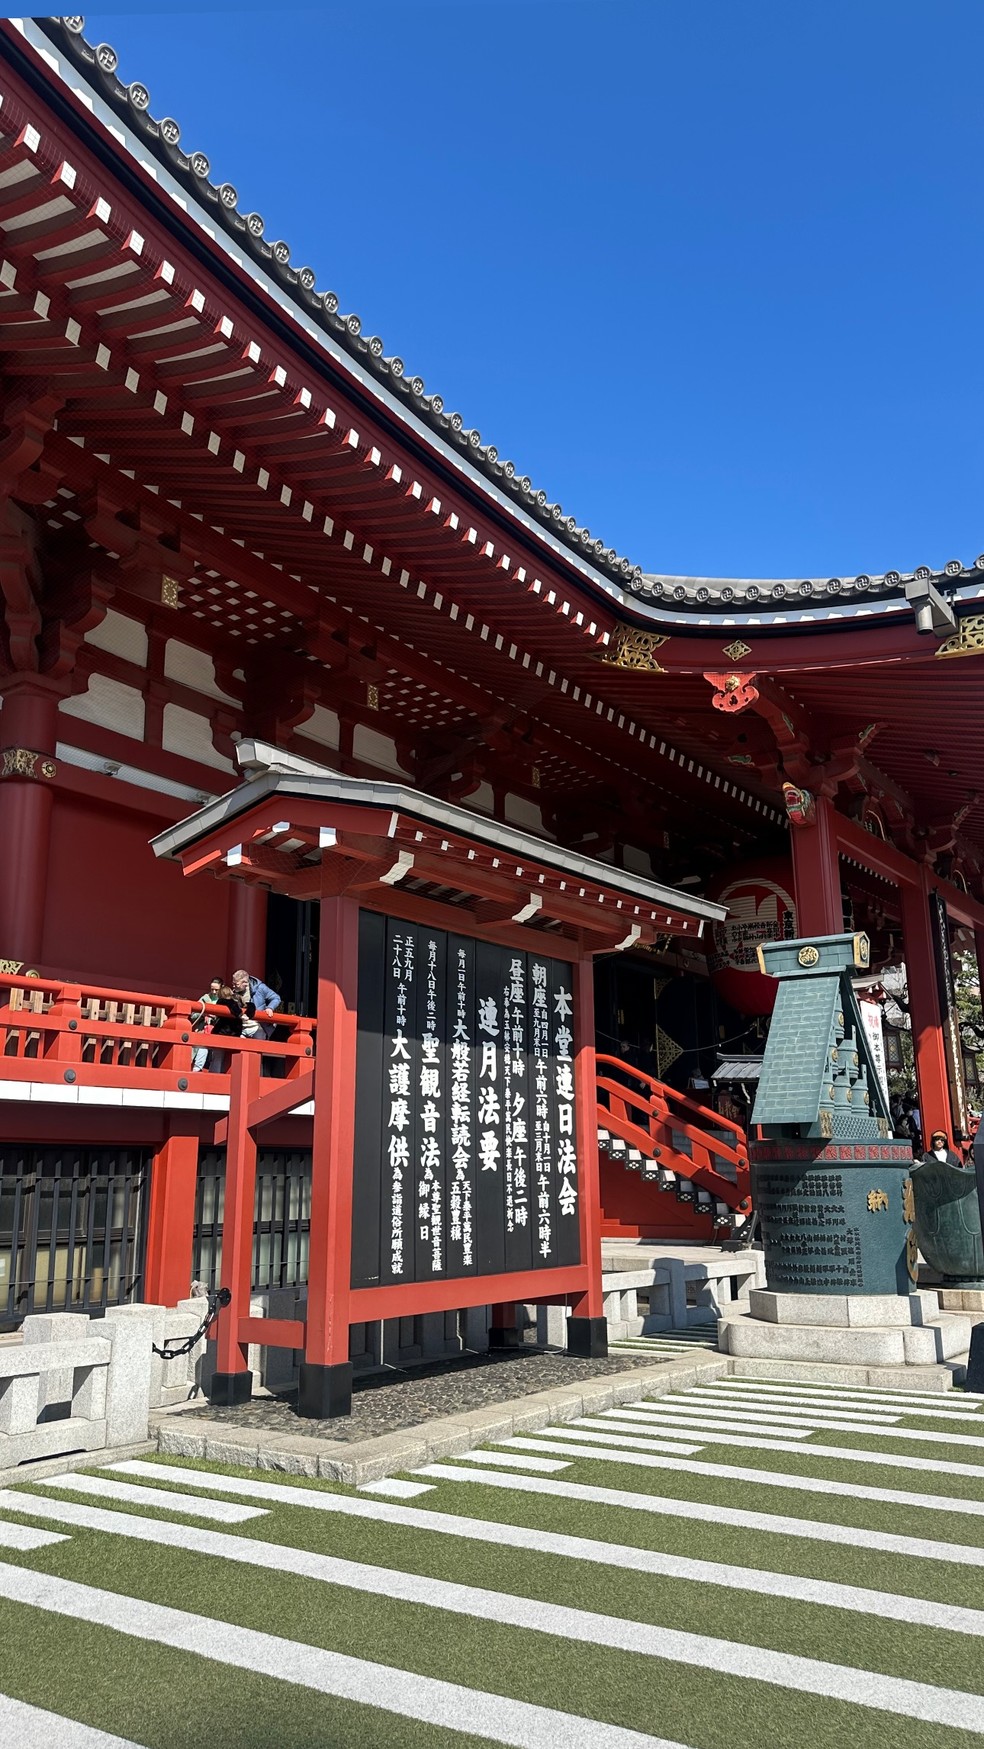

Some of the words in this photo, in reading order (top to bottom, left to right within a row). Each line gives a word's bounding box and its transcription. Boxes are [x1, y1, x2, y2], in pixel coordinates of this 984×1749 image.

[393, 935, 403, 978] 二十八日
[404, 937, 414, 981] 正五九月
[427, 941, 437, 1030] 毎月十八日午後二時
[458, 950, 466, 1018] 毎月一日午前十時
[532, 963, 547, 1009] 朝座
[397, 983, 407, 1026] 午前十時
[508, 959, 525, 1079] 昼座午前十時
[388, 1029, 411, 1167] 大護摩供
[420, 1033, 441, 1167] 聖観音法
[451, 1019, 471, 1169] 大般若経転読会
[478, 997, 500, 1171] 連月法要
[536, 1059, 548, 1118] 午前六時
[554, 986, 577, 1215] 本堂連日法会
[511, 1092, 528, 1226] 夕座午後二時
[419, 1181, 430, 1240] 御縁日
[538, 1175, 551, 1257] 午前六時半
